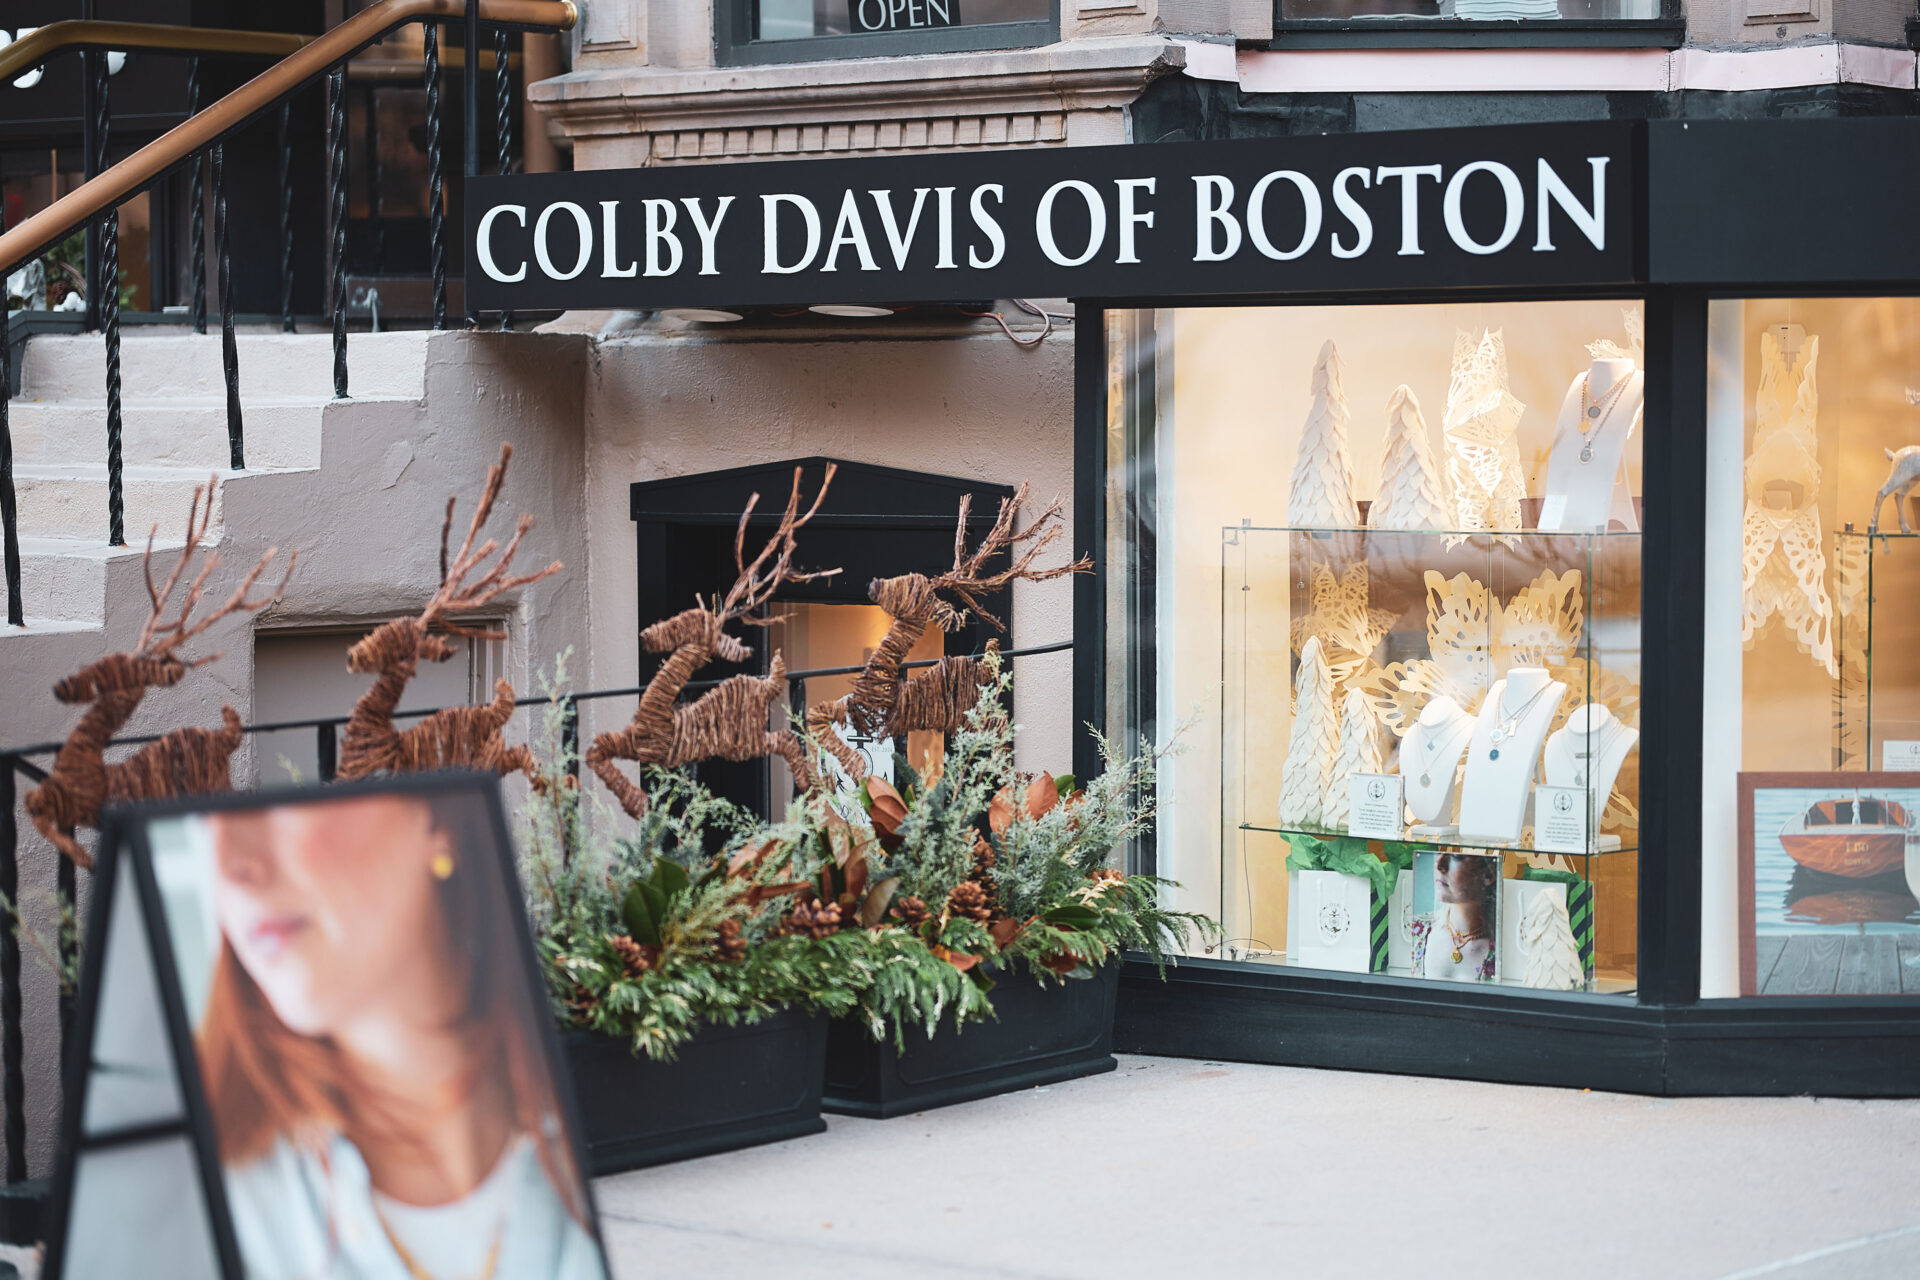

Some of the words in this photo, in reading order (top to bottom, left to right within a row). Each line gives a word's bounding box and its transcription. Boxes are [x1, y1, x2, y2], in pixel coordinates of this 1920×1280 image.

[858, 0, 950, 30] OPEN
[476, 196, 736, 283] COLBY
[760, 184, 1006, 274] DAVIS
[1036, 177, 1156, 267] OF
[1192, 157, 1610, 262] BOSTON
